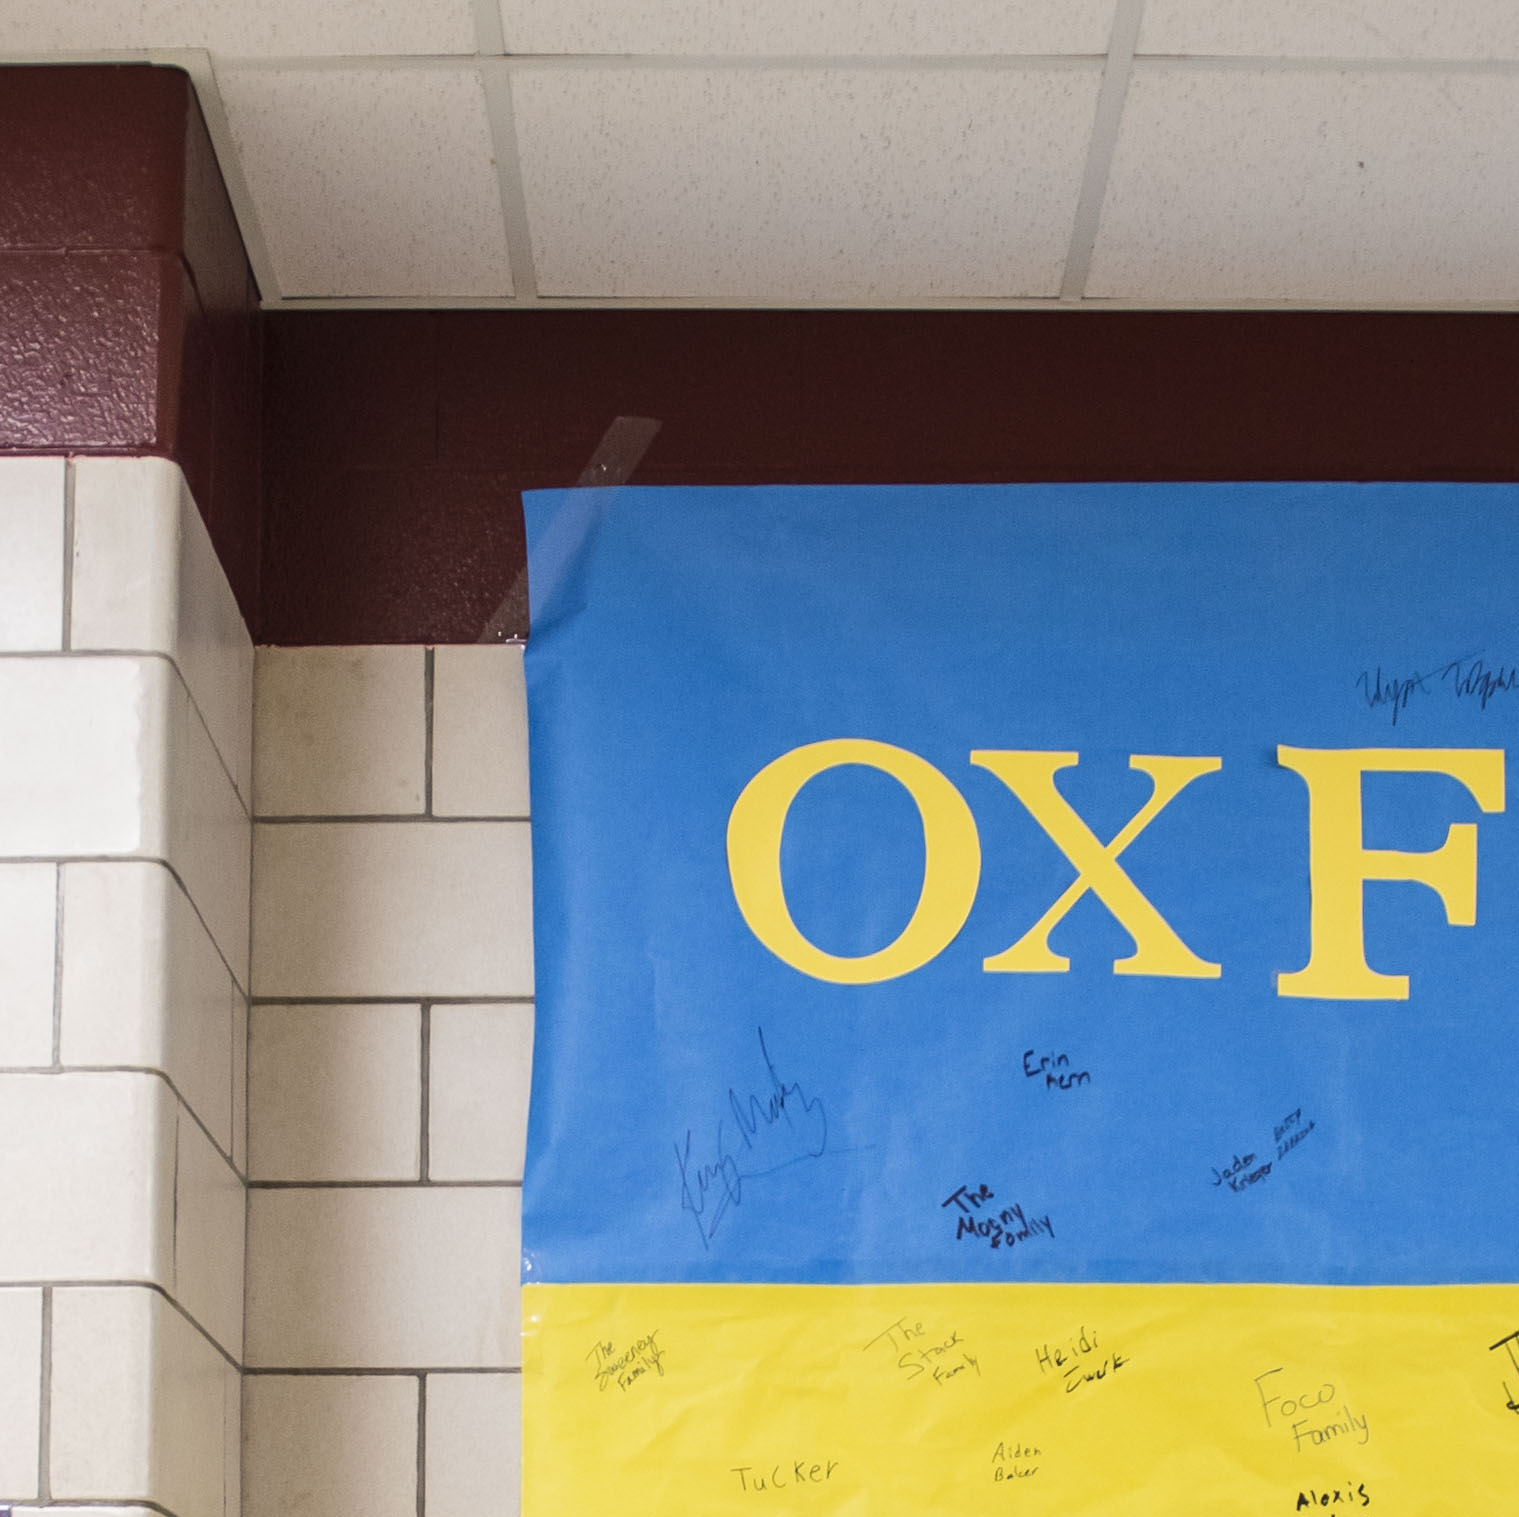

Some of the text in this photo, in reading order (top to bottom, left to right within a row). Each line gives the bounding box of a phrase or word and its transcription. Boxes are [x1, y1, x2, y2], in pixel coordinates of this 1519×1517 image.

[1023, 1050, 1070, 1078] Erin
[941, 1184, 995, 1214] The
[862, 1316, 926, 1353] The
[1035, 1325, 1099, 1375] Heidi
[1291, 1404, 1370, 1453] Family
[990, 1441, 1042, 1464] Aiden
[729, 1459, 840, 1492] Tucker
